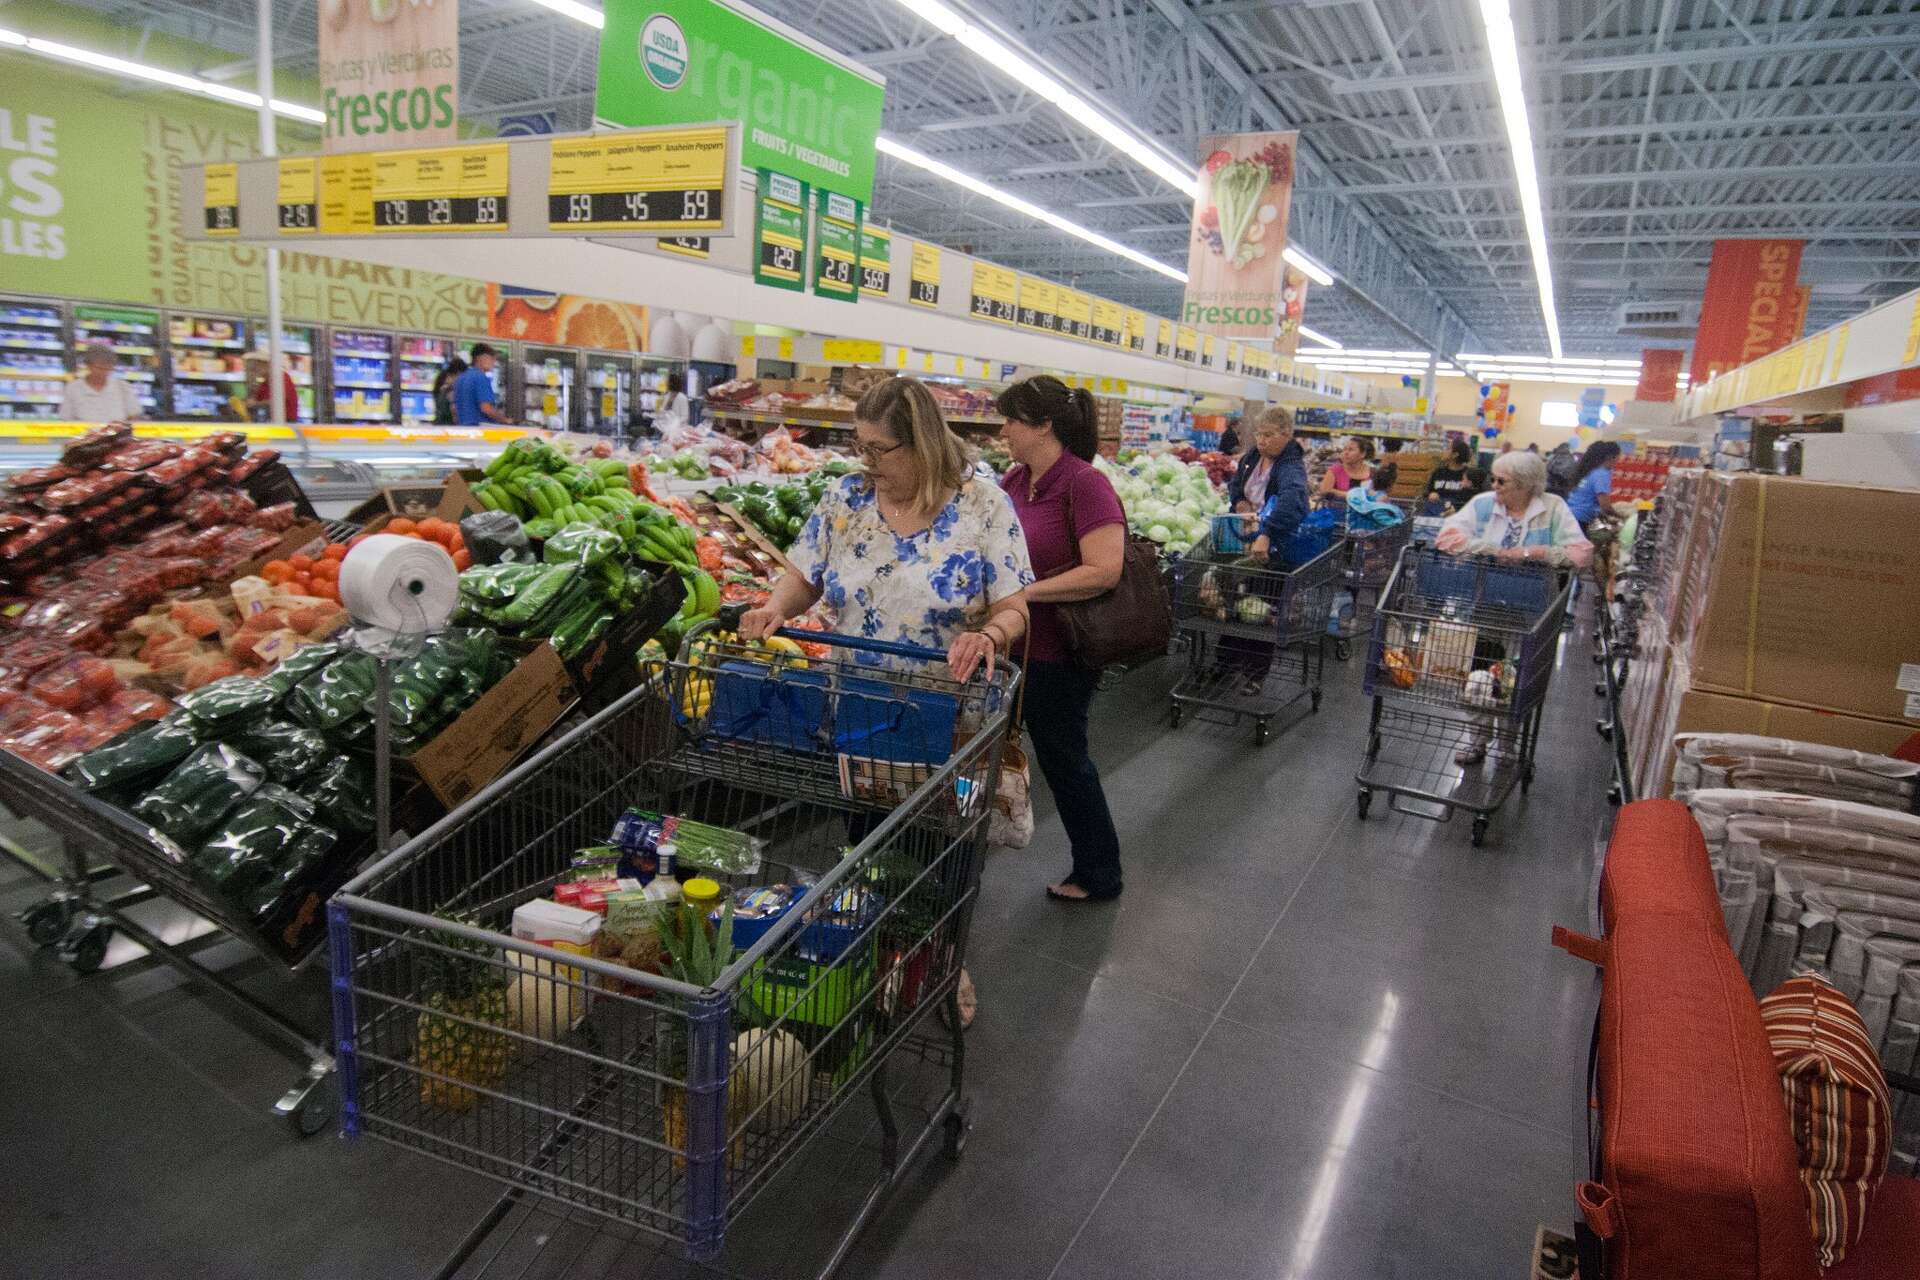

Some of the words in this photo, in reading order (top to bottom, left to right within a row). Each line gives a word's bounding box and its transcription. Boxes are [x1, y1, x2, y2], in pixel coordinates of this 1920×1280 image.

[652, 31, 679, 54] USDA
[324, 83, 454, 138] Frescos
[696, 142, 724, 151] Peppers
[752, 127, 788, 156] FRUITS
[796, 144, 851, 178] VEGETABLES
[0, 156, 65, 218] S
[567, 194, 592, 222] .69
[622, 192, 649, 220] .45
[680, 190, 709, 220] .69
[774, 246, 795, 270] 1.29
[326, 282, 438, 330] EVERY
[1184, 302, 1275, 326] Frescos
[1741, 243, 1791, 360] SPECIAL
